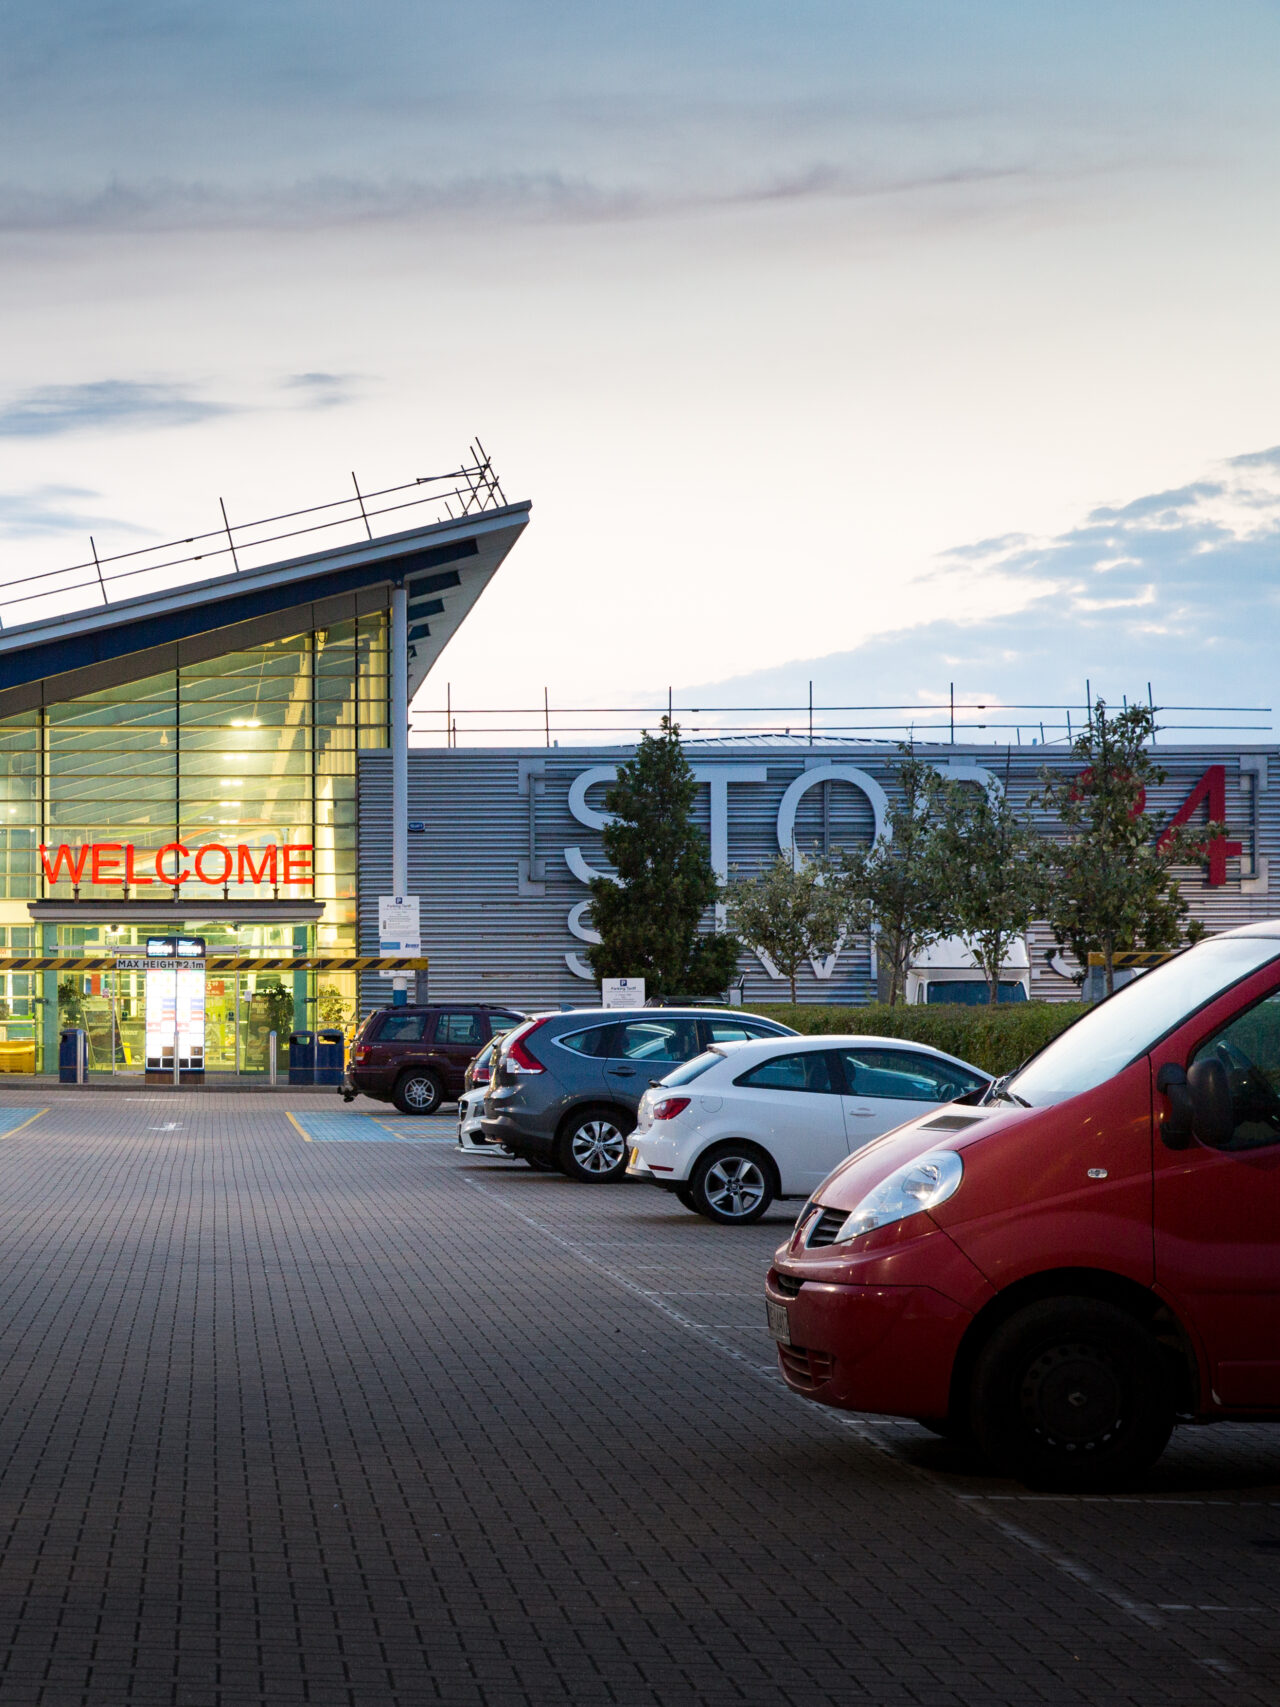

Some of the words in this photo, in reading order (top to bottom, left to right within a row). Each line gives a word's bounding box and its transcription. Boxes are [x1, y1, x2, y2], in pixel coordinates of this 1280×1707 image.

[39, 844, 314, 885] WELCOME
[118, 960, 139, 968] MAX
[143, 960, 180, 968] HEIGHT
[183, 960, 204, 968] 2.1m
